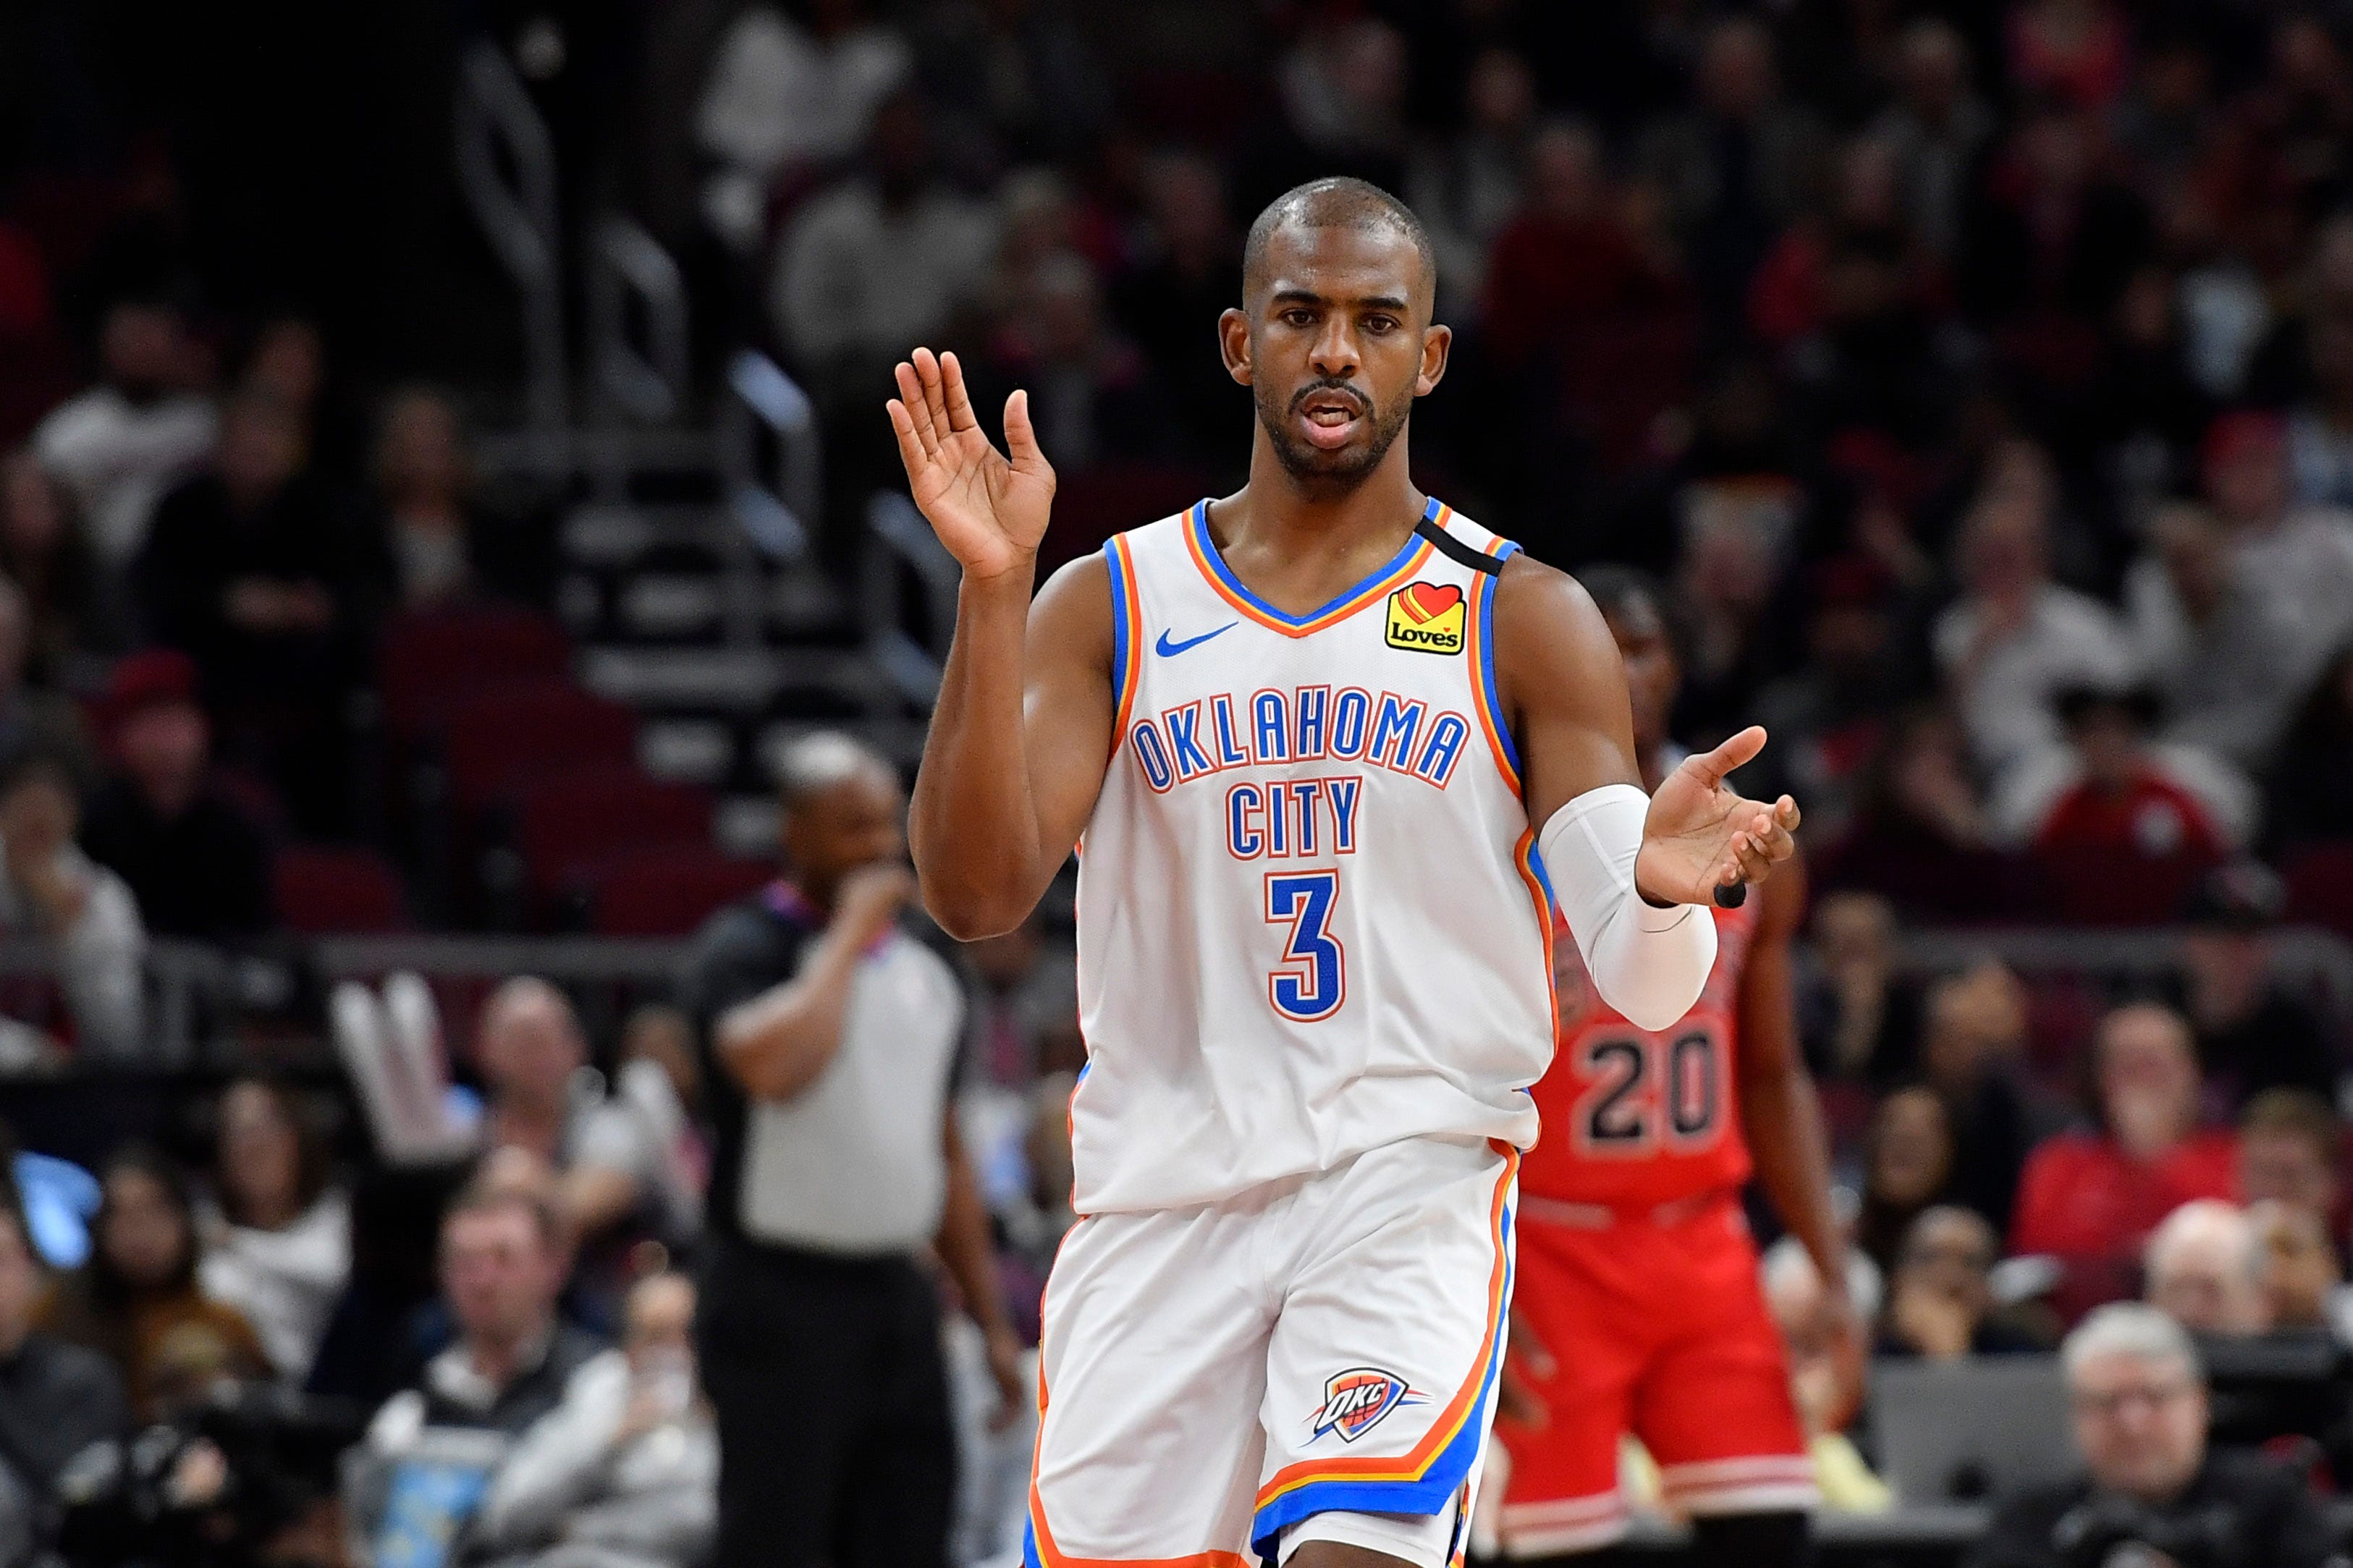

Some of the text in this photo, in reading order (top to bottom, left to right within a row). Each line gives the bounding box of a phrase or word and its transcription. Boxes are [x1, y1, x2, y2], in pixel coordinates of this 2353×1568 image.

[1131, 685, 1471, 794] OKLAHOMA
[1226, 776, 1362, 860] CITY
[1264, 869, 1346, 1022] 3
[1576, 1023, 1725, 1153] 20
[1314, 1381, 1387, 1432] OKC
